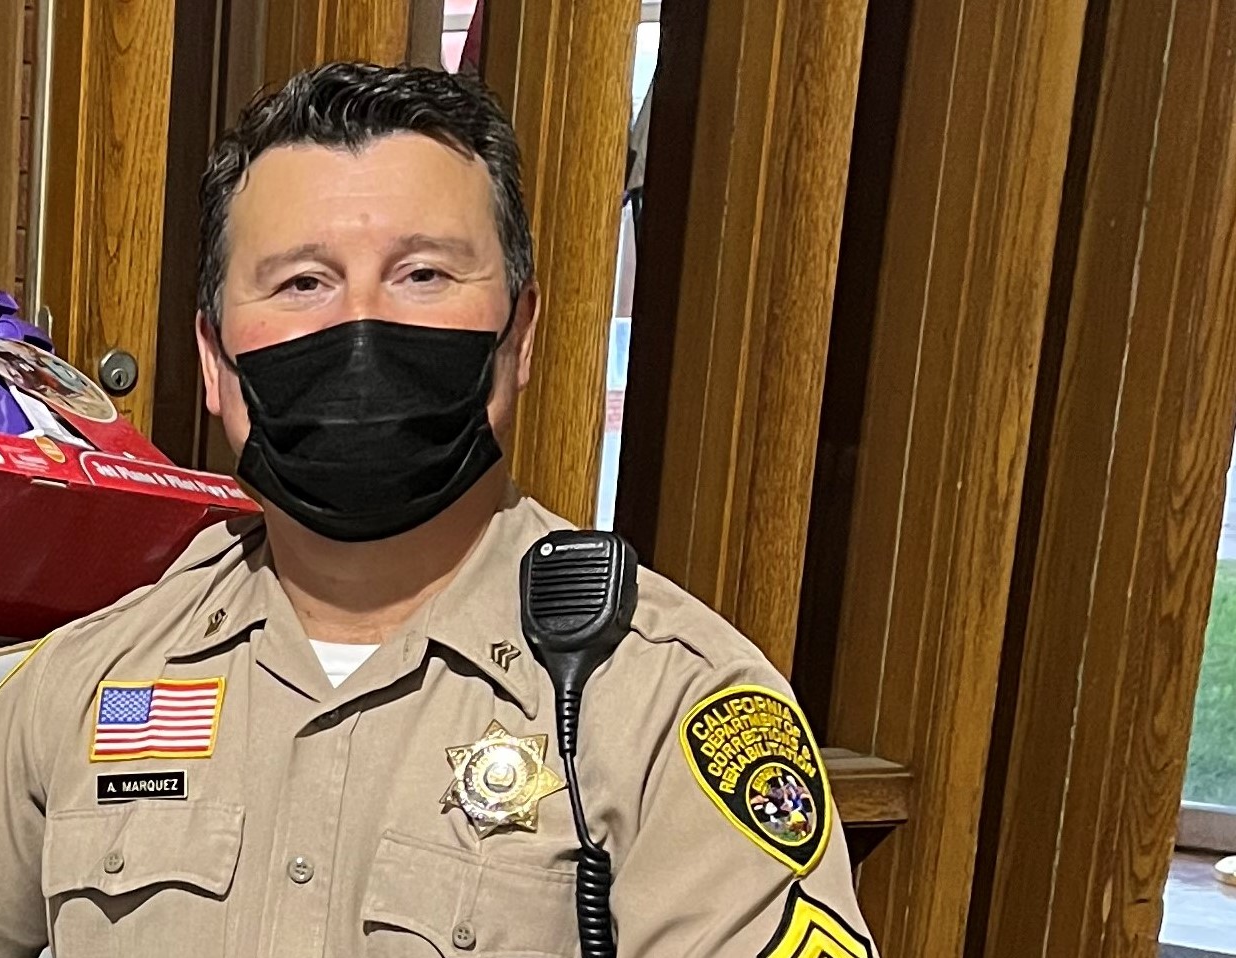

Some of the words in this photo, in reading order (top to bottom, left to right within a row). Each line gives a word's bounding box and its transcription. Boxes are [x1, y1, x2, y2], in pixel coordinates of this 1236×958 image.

[692, 696, 794, 741] CALIFORNIA
[700, 713, 783, 758] DEPARTMENT
[707, 727, 799, 777] CORRECTIONS
[719, 741, 817, 794] REHABILITATION
[122, 779, 178, 792] MARQUEZ
